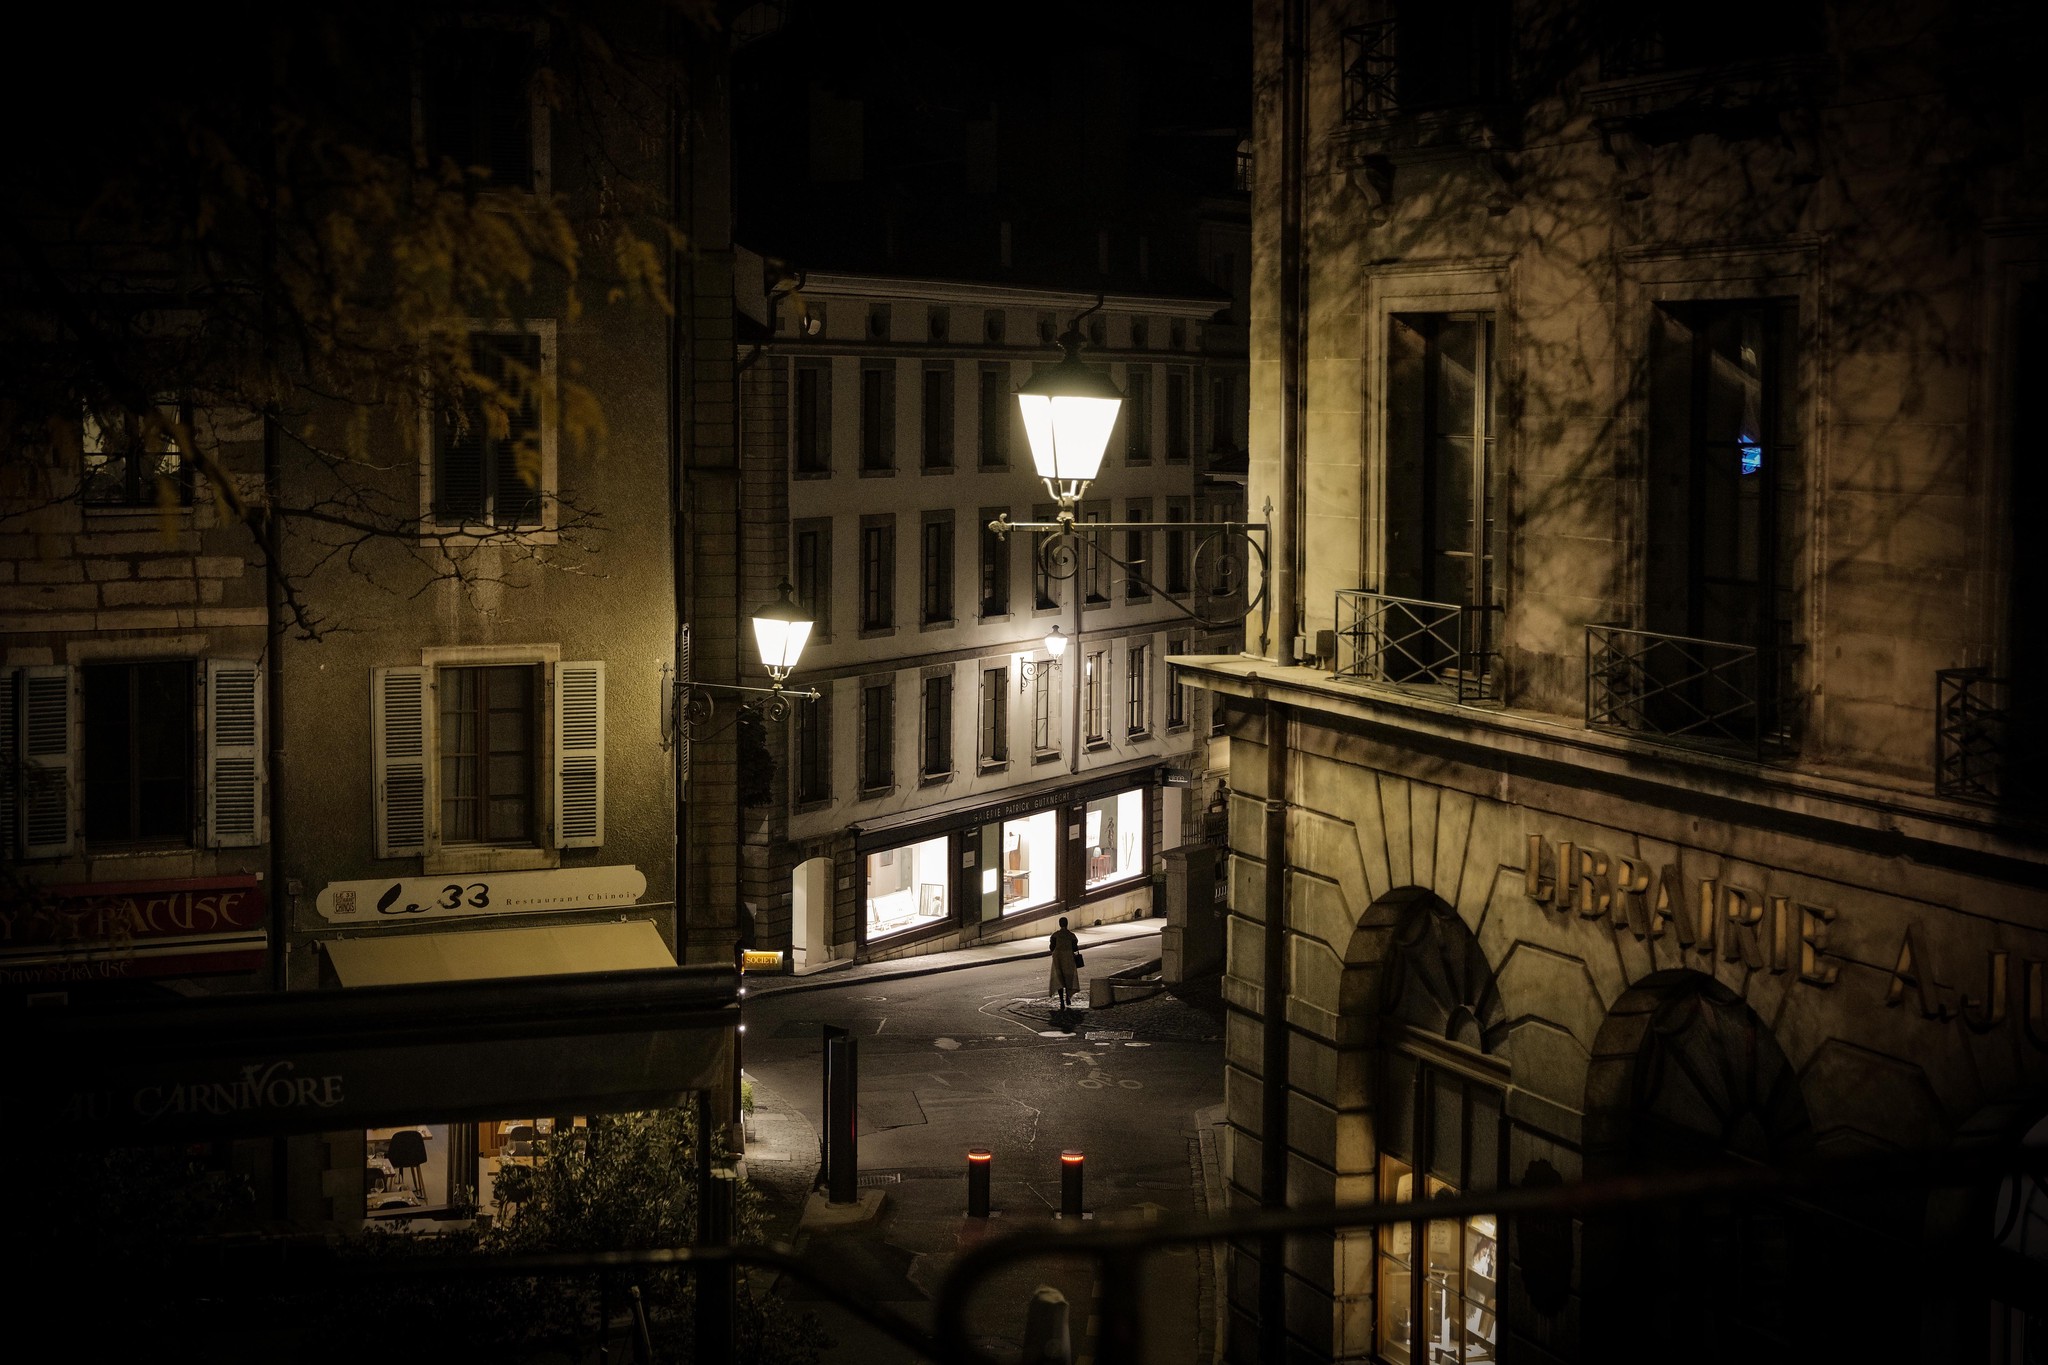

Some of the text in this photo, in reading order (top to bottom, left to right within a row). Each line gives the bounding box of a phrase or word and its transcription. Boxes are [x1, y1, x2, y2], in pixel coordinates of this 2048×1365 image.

[1005, 801, 1030, 815] PATRICK
[1034, 792, 1070, 809] GUTKNECHT
[437, 883, 490, 909] 33
[506, 896, 579, 905] Restaurant
[587, 891, 637, 901] Chinois
[1526, 833, 1840, 988] LIBRAIRIE
[746, 956, 779, 964] SOCIETY
[132, 1060, 345, 1125] CARNIVORE
